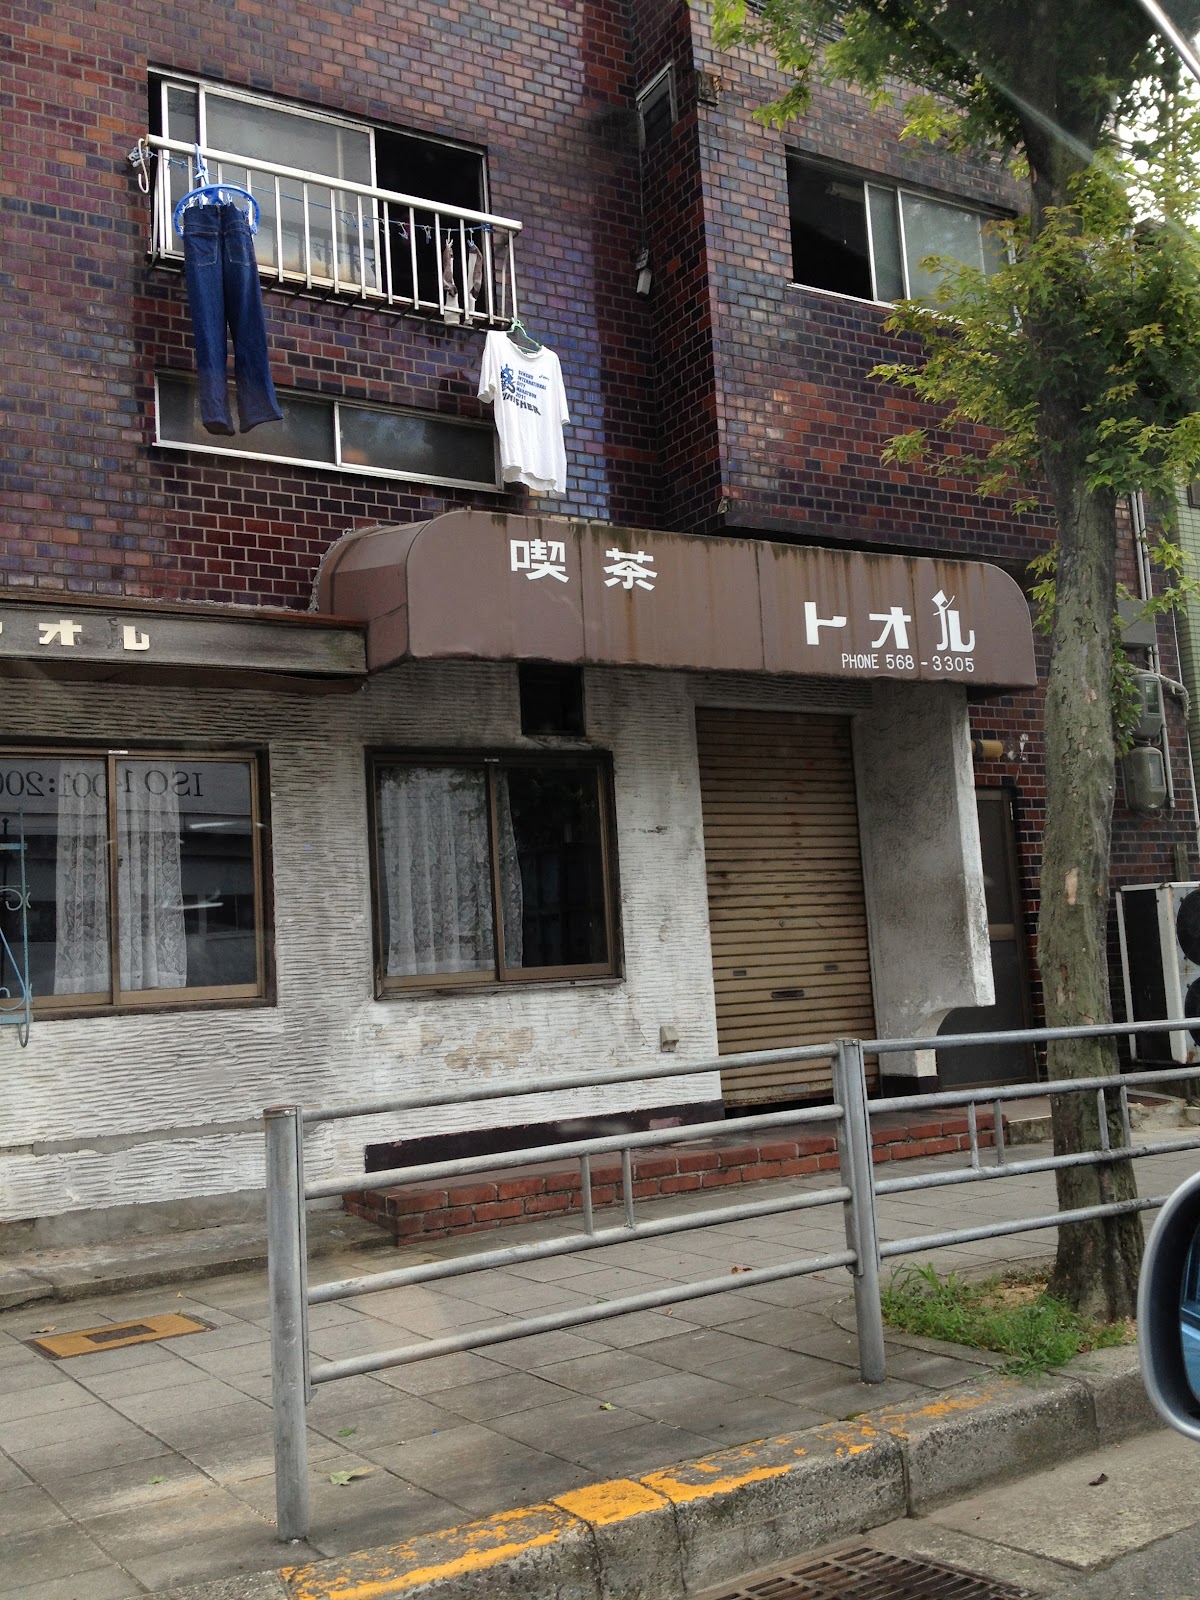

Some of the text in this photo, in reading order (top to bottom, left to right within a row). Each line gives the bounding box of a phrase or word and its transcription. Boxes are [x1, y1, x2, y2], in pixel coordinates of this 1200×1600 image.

[516, 381, 526, 389] CITY
[517, 375, 547, 390] INTERNATIONAL
[515, 392, 527, 400] 2011
[516, 387, 537, 399] MARATHON
[510, 539, 976, 653] 喫茶 トオル
[841, 653, 880, 669] PHONE
